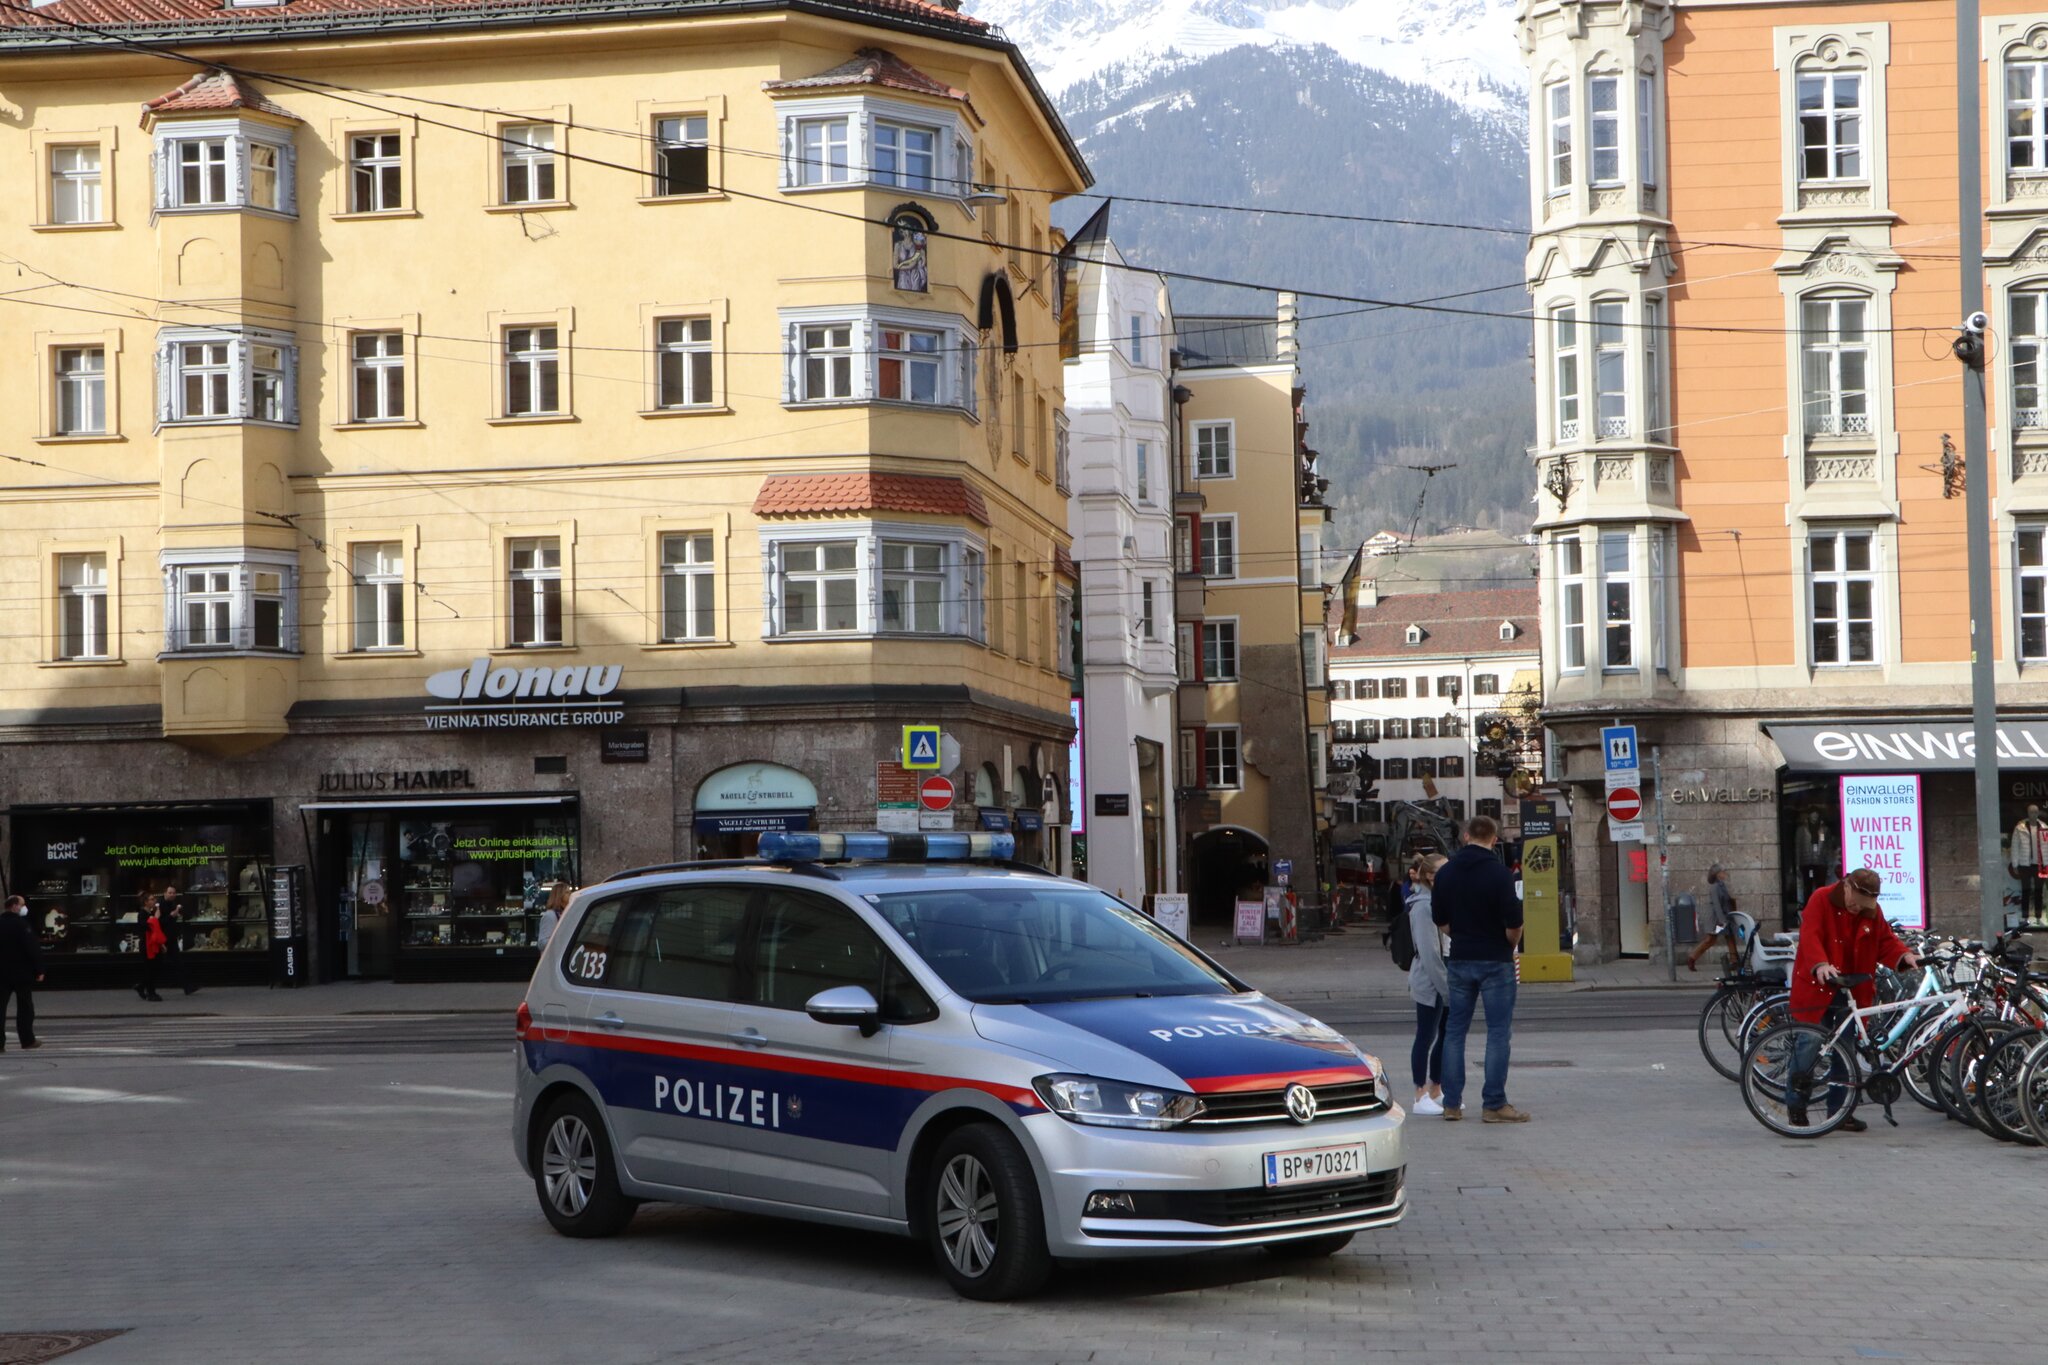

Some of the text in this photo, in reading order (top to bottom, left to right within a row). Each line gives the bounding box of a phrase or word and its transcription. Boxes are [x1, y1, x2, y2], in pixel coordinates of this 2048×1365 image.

[425, 657, 624, 699] donau
[425, 711, 624, 729] VIENNA INSURANCE GROUP
[318, 770, 475, 791] JULIUS HAMPL
[1847, 796, 1915, 805] FASHION STORES
[1850, 816, 1912, 832] WINTER
[47, 842, 77, 851] MONT
[104, 844, 225, 855] Jetzt Online einkaufen bei
[453, 838, 477, 848] Jetzt
[479, 837, 510, 847] Online
[512, 836, 558, 847] einkaufen
[1860, 834, 1905, 851] FINAL
[47, 851, 78, 860] BLANC
[119, 857, 209, 868] www.juliushampl.at
[470, 849, 562, 860] www.juliushampl.at
[1863, 853, 1902, 869] SALE
[580, 951, 607, 979] 133
[655, 1075, 779, 1128] POLIZEI
[1283, 1150, 1358, 1178] BP 70321
